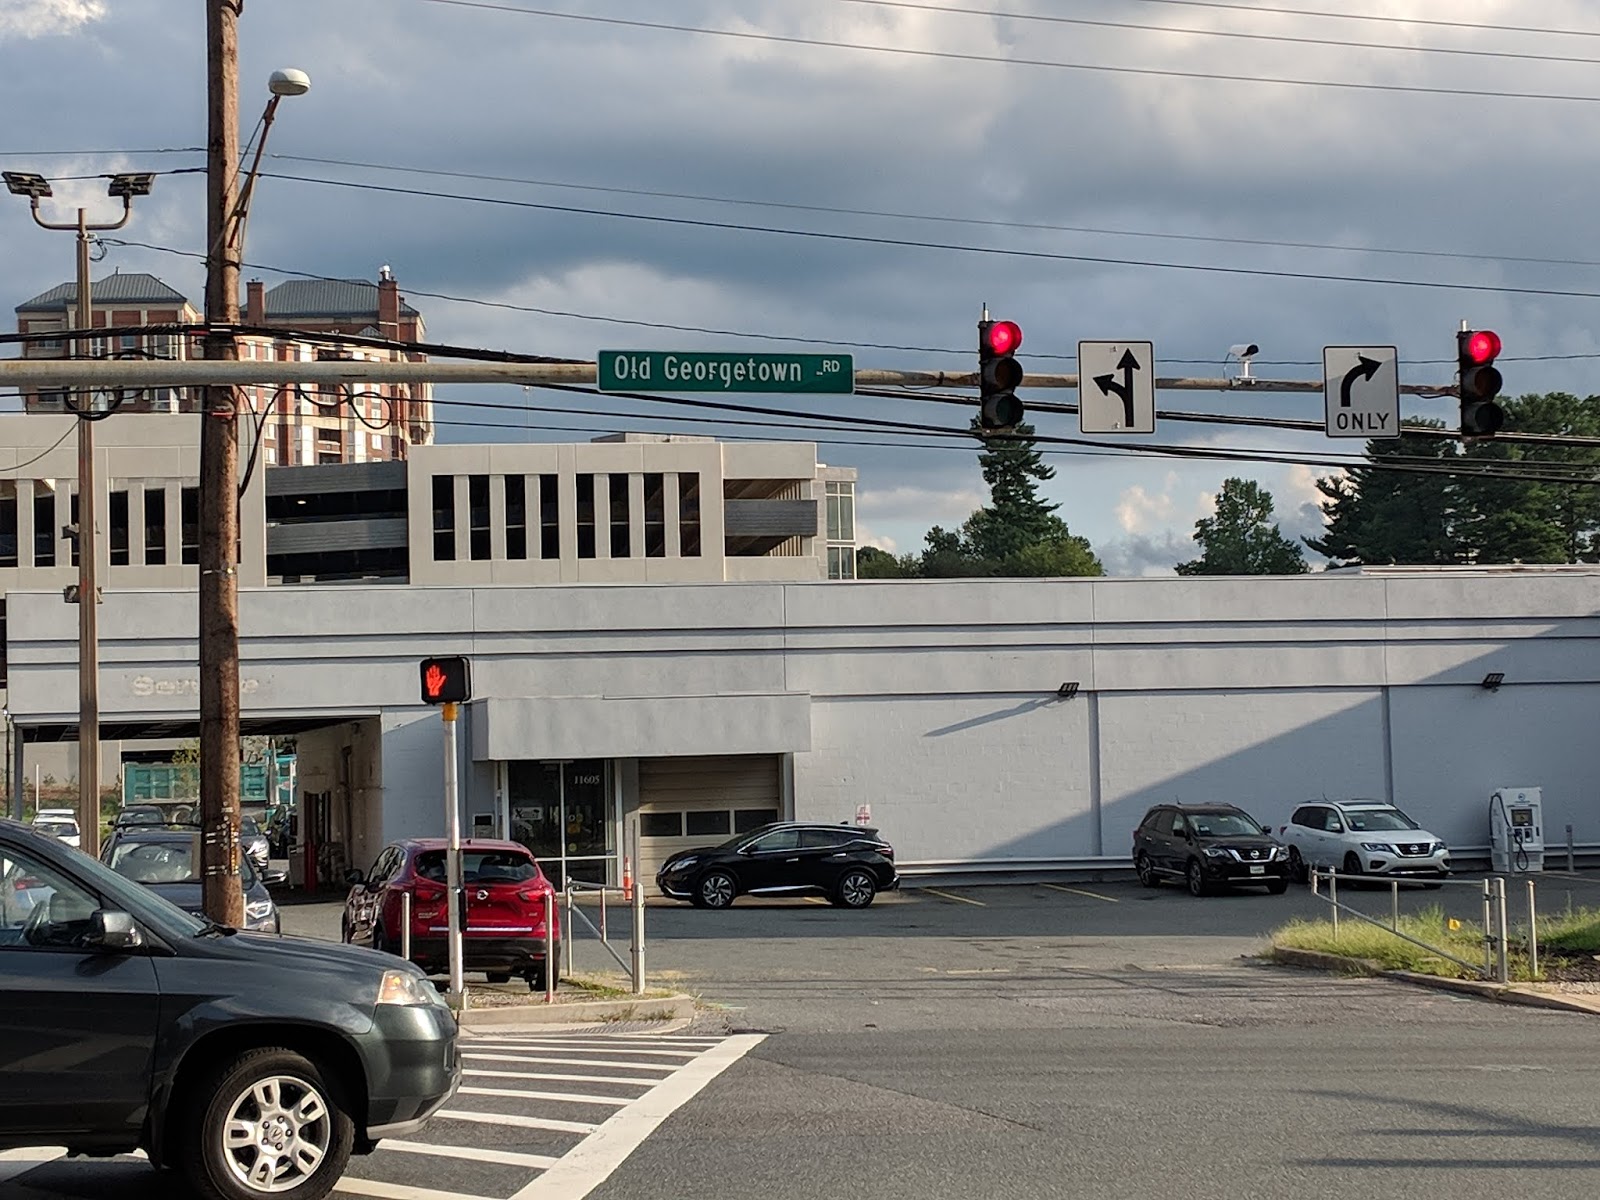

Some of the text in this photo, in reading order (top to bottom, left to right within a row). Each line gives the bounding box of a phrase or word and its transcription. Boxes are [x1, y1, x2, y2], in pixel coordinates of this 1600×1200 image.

[614, 354, 841, 388] Old Georgetown RD
[1336, 412, 1390, 430] ONLY
[133, 675, 260, 696] Sere
[574, 774, 600, 785] 11605
